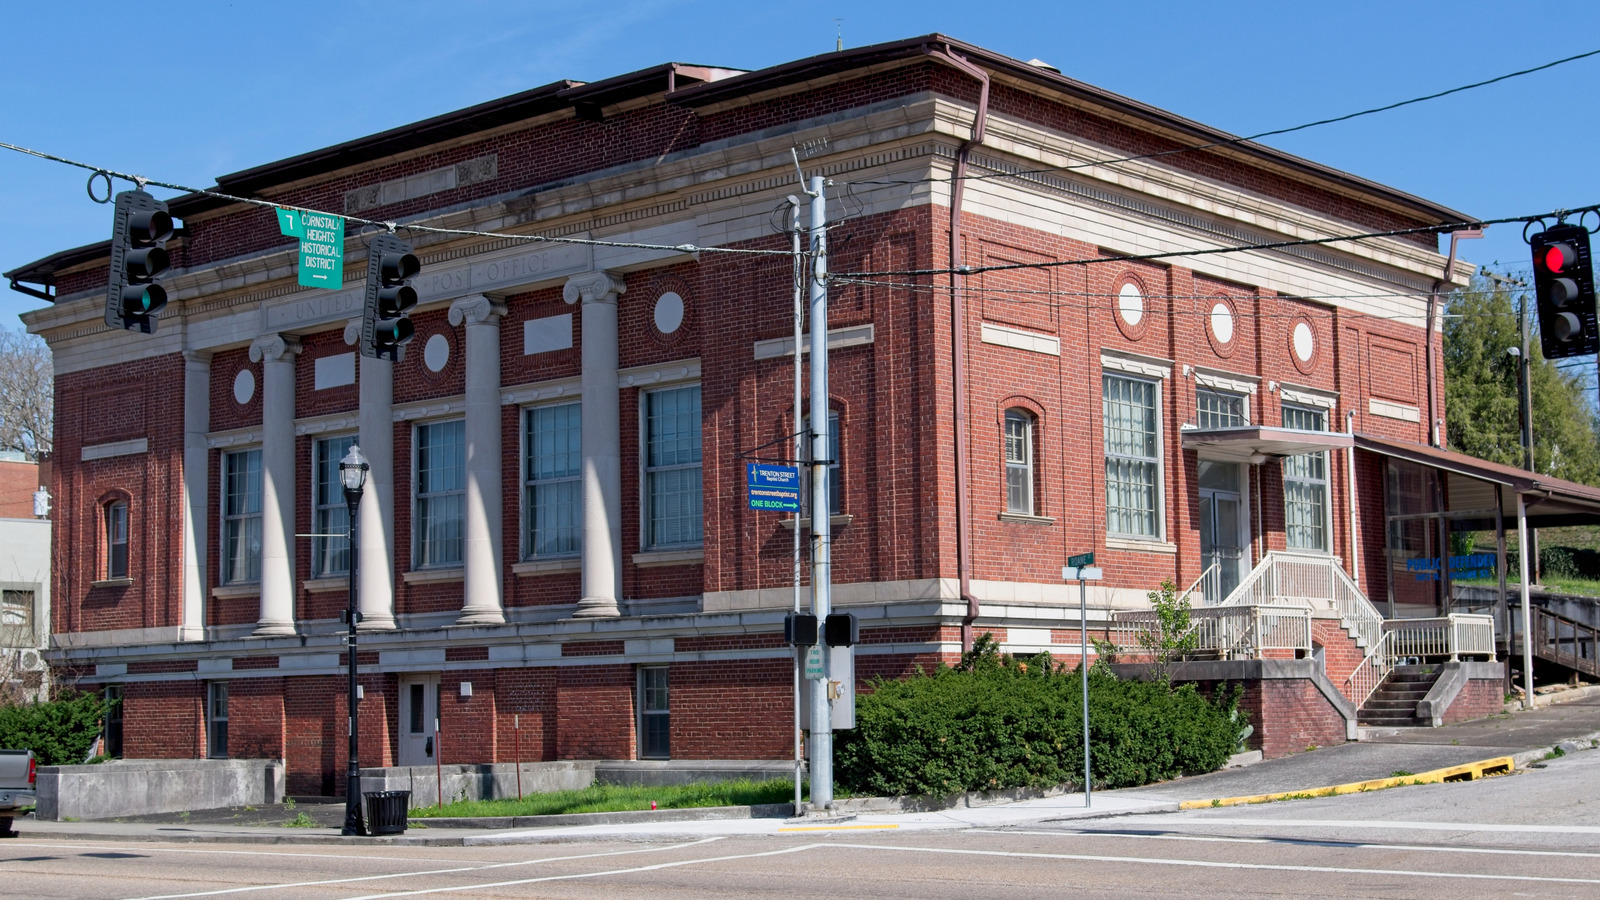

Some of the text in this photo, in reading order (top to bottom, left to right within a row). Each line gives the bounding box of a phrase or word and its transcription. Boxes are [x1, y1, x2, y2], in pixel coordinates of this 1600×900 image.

[285, 214, 294, 230] 7
[301, 214, 341, 230] CORNSTALK
[306, 228, 336, 243] HEIGHTS
[301, 242, 341, 258] HISTORICAL
[305, 256, 336, 270] DISTRICT
[296, 293, 353, 320] UNITED
[432, 268, 471, 292] POST
[487, 252, 550, 281] OFFICE
[750, 500, 784, 508] ONE BLOCK
[1406, 554, 1496, 571] PUBLIC DEFENDER
